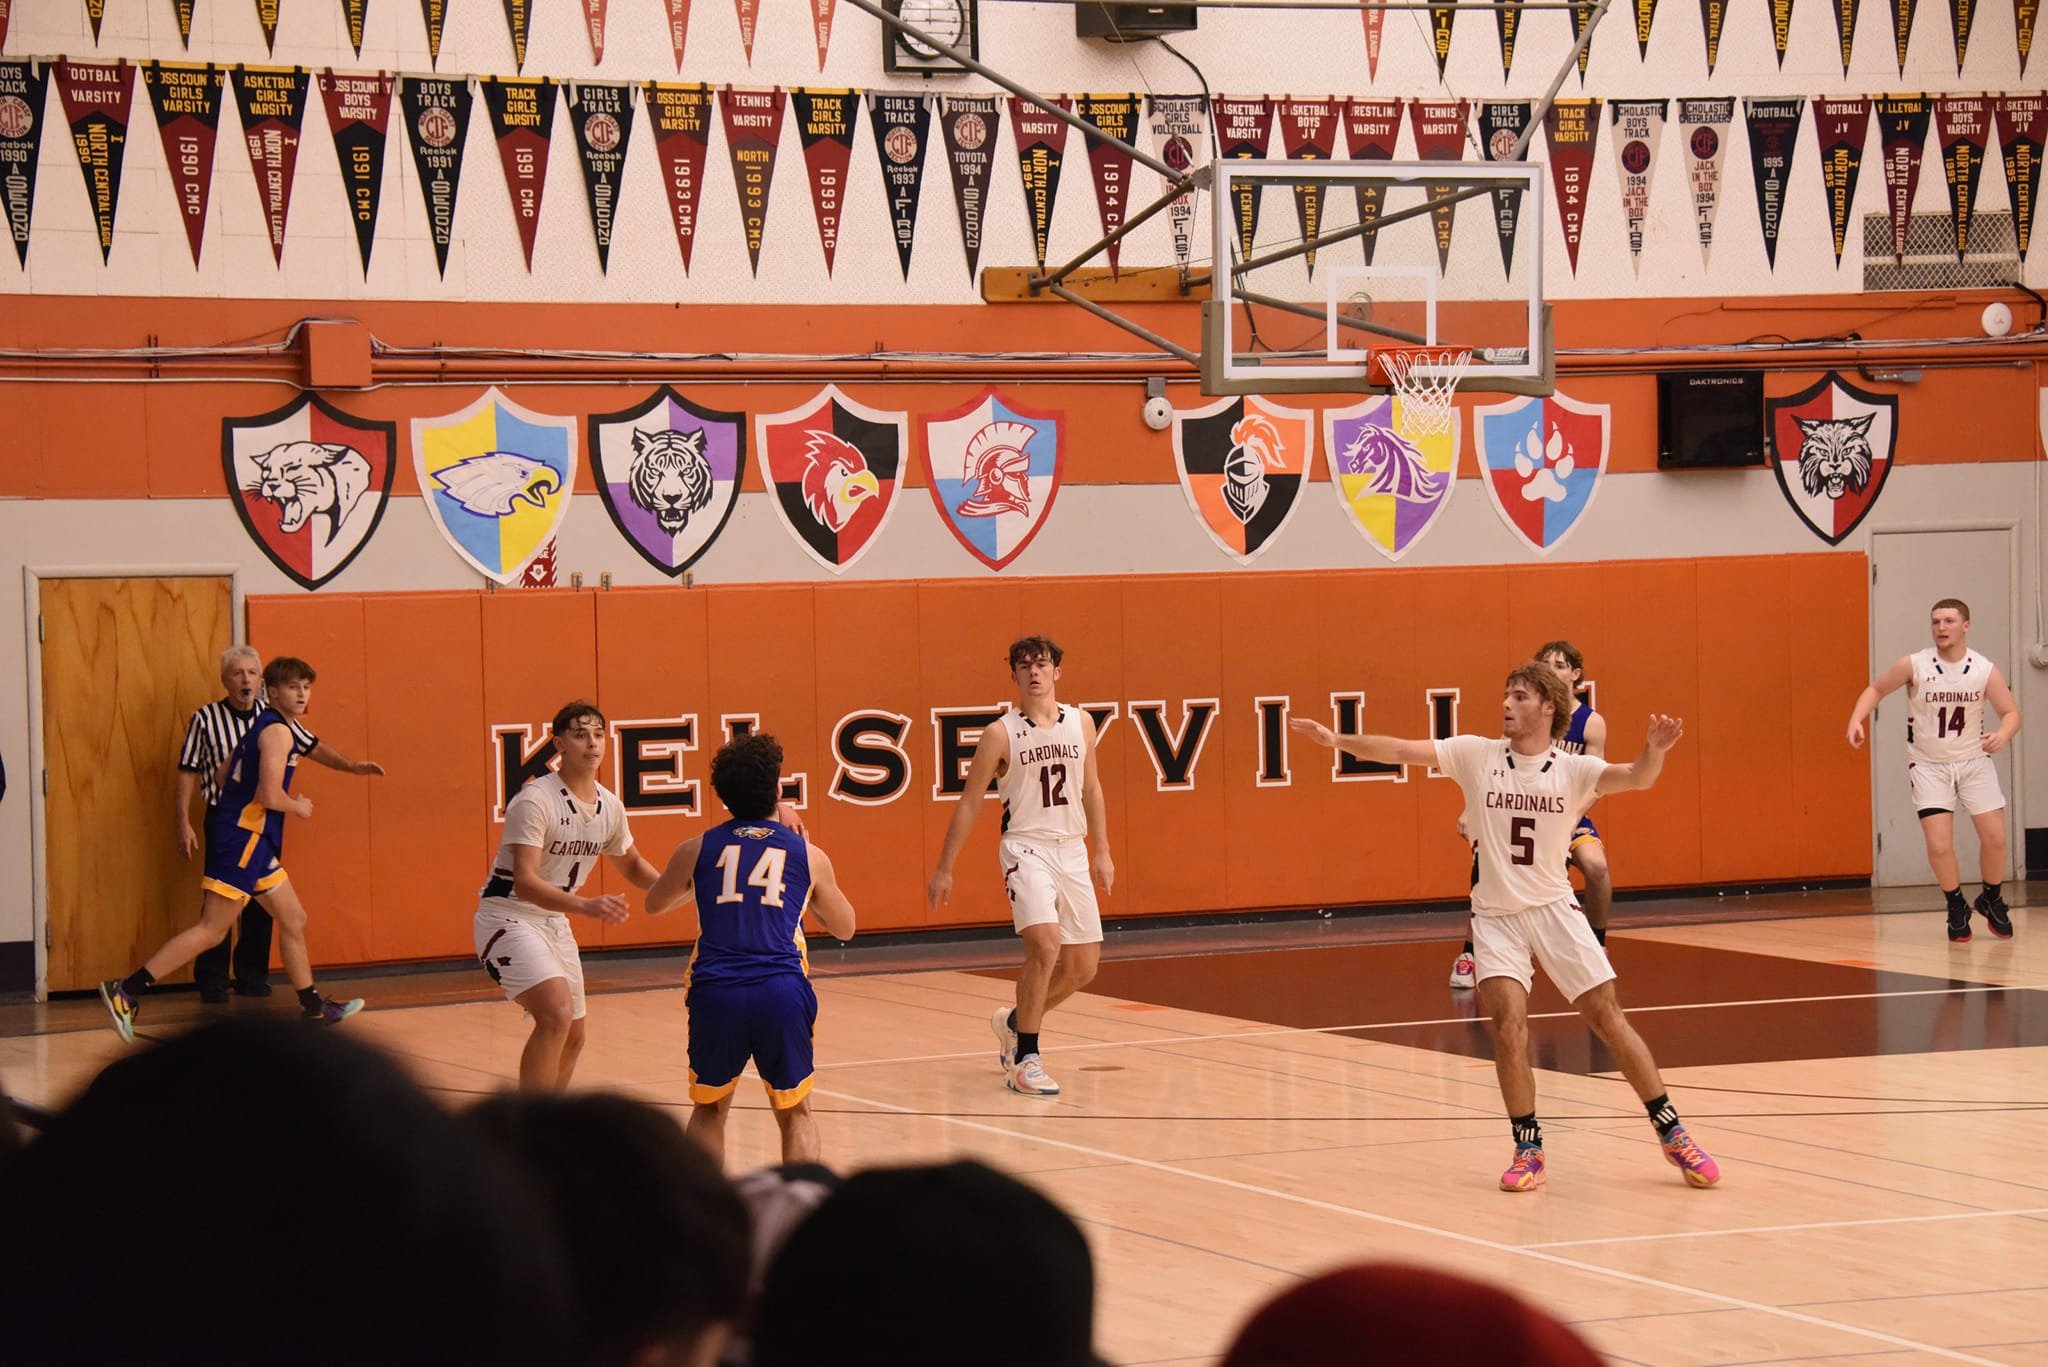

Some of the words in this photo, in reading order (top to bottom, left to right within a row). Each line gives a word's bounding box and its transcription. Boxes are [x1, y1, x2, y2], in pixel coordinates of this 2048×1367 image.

[170, 87, 203, 99] GIRLS
[421, 83, 451, 95] BOYS
[506, 87, 536, 100] TRACK
[584, 88, 618, 100] GIRLS
[72, 90, 120, 104] VARSITY
[256, 90, 287, 102] GIRLS
[345, 95, 370, 106] BOYS
[417, 95, 456, 108] TRACK
[735, 95, 771, 108] TENNIS
[163, 99, 210, 113] VARSITY
[250, 102, 293, 116] VARSITY
[507, 101, 536, 113] GIRLS
[583, 101, 621, 113] TRACK
[811, 98, 842, 110] TRACK
[885, 99, 915, 110] GIRLS
[947, 101, 993, 113] FOOTBALL
[339, 107, 377, 120] VARSITY
[665, 106, 695, 118] GIRLS
[812, 110, 841, 122] GIRLS
[1424, 107, 1457, 118] TENNIS
[1491, 106, 1518, 116] GIRLS
[1558, 108, 1585, 119] TRACK
[1752, 107, 1795, 118] FOOTBALL
[2011, 112, 2033, 122] BOYS
[503, 114, 540, 126] VARSITY
[733, 114, 772, 127] VARSITY
[884, 112, 916, 123] TRACK
[1097, 115, 1123, 126] GIRLS
[1165, 113, 1189, 123] GIRLS
[1233, 116, 1255, 127] BOYS
[1298, 117, 1320, 128] BOYS
[1491, 117, 1520, 128] TRACK
[1627, 119, 1647, 128] BOYS
[1679, 114, 1731, 124] CHEERLEADERS
[1953, 113, 1973, 123] BOYS
[426, 115, 449, 137] CIF
[660, 118, 700, 131] VARSITY
[807, 123, 847, 135] VARSITY
[1021, 123, 1058, 134] VARSITY
[1152, 124, 1202, 135] VOLLEYBALL
[1353, 124, 1390, 135] VARSITY
[1423, 124, 1458, 135] VARSITY
[1559, 120, 1585, 131] GIRLS
[1947, 124, 1981, 134] VARSITY
[960, 121, 982, 141] CIF
[1226, 128, 1262, 139] VARSITY
[1555, 132, 1590, 142] VARSITY
[1625, 128, 1650, 138] TRACK
[75, 134, 91, 163] 1990
[88, 124, 108, 166] NORTH
[248, 136, 263, 160] 1991
[264, 130, 281, 167] NORTH
[892, 134, 912, 154] CIF
[0, 150, 27, 162] 1990
[179, 137, 198, 176] 1990
[737, 150, 769, 162] NORTH
[954, 152, 987, 163] TOYOTA
[352, 147, 369, 179] 1991
[427, 157, 452, 169] 1991
[515, 148, 533, 179] 1991
[592, 160, 615, 172] 1991
[1033, 149, 1047, 187] NORTH
[1694, 161, 1715, 171] JACK
[1764, 157, 1783, 168] 1995
[1835, 149, 1848, 187] NORTH
[1896, 148, 1909, 185] NORTH
[1956, 145, 1969, 186] NORTH
[2017, 145, 2030, 186] NORTH
[437, 169, 443, 180] A
[960, 165, 982, 175] 1994
[1022, 160, 1033, 189] 1994
[1771, 169, 1776, 178] A
[1825, 161, 1834, 188] 1995
[1886, 159, 1895, 185] 1995
[1946, 158, 1956, 183] 1995
[2005, 157, 2016, 182] 1995
[601, 173, 607, 184] A
[674, 159, 691, 200] 1993
[893, 174, 915, 184] 1993
[969, 176, 974, 186] A
[1627, 176, 1646, 185] 1994
[1692, 172, 1702, 181] IN
[1704, 171, 1718, 181] THE
[94, 169, 109, 213] CENTRAL
[267, 171, 282, 212] CENTRAL
[746, 166, 761, 208] 1993
[820, 168, 836, 209] 1993
[1104, 164, 1119, 207] 1994
[1564, 167, 1579, 205] 1994
[1625, 187, 1646, 196] JACK
[1698, 183, 1713, 192] BOX
[900, 187, 906, 197] A
[1696, 193, 1715, 203] 1994
[185, 183, 199, 214] CMC
[356, 188, 370, 220] CMC
[521, 189, 534, 217] CMC
[1623, 198, 1632, 207] IN
[1635, 197, 1648, 207] THE
[1958, 185, 1968, 223] CENTRAL
[2018, 184, 2029, 221] CENTRAL
[1035, 190, 1046, 229] CENTRAL
[1171, 207, 1191, 216] 1994
[1629, 208, 1644, 217] BOX
[1835, 189, 1848, 225] CENTRAL
[1896, 189, 1907, 226] CENTRAL
[678, 205, 691, 236] CMC
[99, 216, 111, 247] LEAGUE
[271, 215, 282, 244] LEAGUE
[748, 218, 760, 249] CMC
[823, 217, 835, 248] CMC
[1567, 213, 1578, 243] CMC
[1689, 377, 1744, 386] DAKTRONICS
[1925, 691, 1980, 703] CARDINALS
[1937, 706, 1966, 738] 14
[1020, 743, 1079, 766] CARDINALS
[1040, 763, 1068, 808] 12
[1486, 791, 1564, 813] CARDINALS
[1510, 817, 1535, 865] 5
[549, 840, 605, 856] CARDINA
[715, 844, 787, 908] 14
